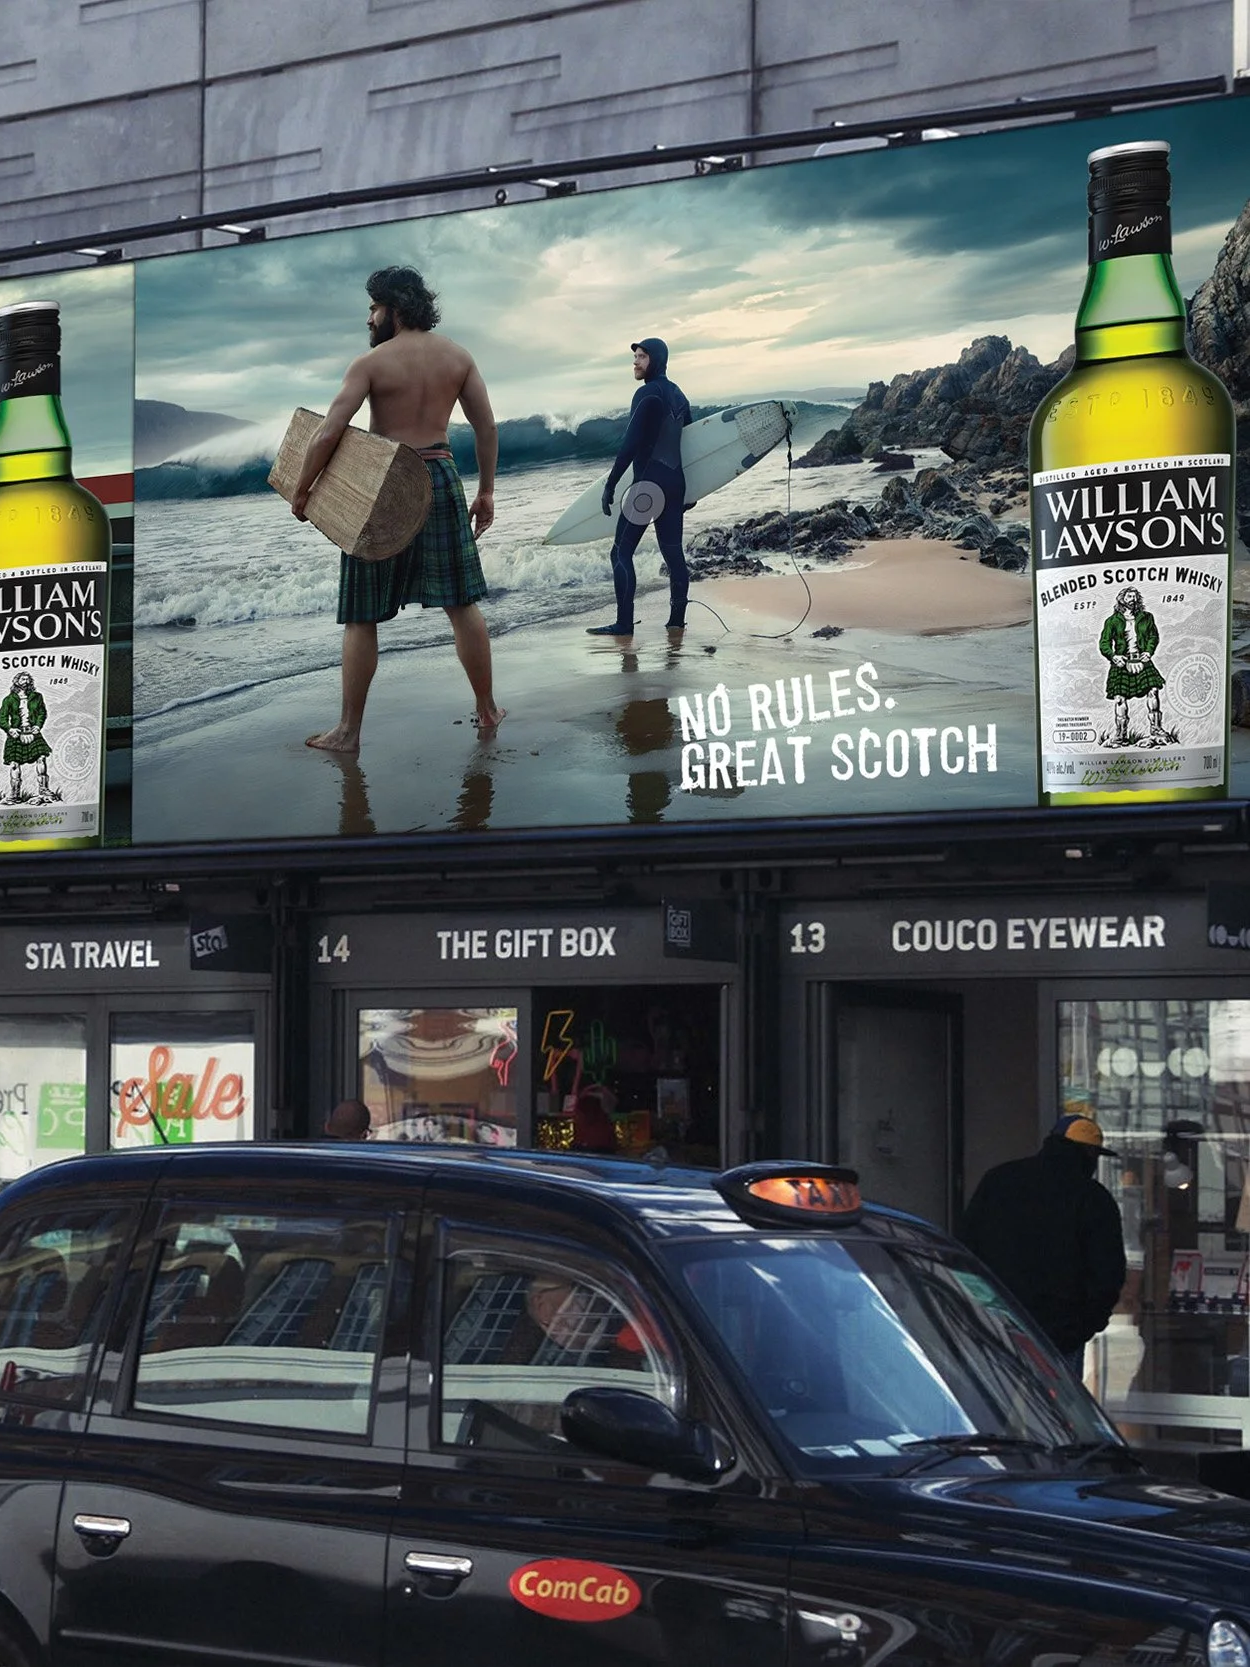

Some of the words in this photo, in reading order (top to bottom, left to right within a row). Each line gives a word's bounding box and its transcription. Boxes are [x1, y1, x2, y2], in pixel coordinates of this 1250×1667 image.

[1084, 468, 1108, 477] AGED
[1124, 462, 1169, 472] BOTTLED
[1045, 476, 1216, 523] WILLIAM
[1040, 512, 1225, 561] LAWSON'S
[20, 567, 57, 576] BOTTLED
[1040, 574, 1097, 607] BLENDED
[1103, 567, 1168, 585] SCOTCH
[1175, 567, 1223, 594] WHISKY
[1162, 594, 1185, 603] 1849
[2, 655, 55, 670] SCOTCH
[61, 655, 100, 677] WHISKY
[678, 683, 732, 742] NO
[748, 661, 898, 732] RULES.
[680, 736, 812, 791] GREAT
[831, 723, 998, 782] SCOTCH
[317, 935, 350, 963] 14
[437, 930, 488, 960] THE
[495, 928, 553, 958] GIFT
[560, 926, 617, 958] BOX
[790, 922, 826, 953] 13
[892, 919, 997, 951] COUCO
[1006, 915, 1166, 950] EYEWEAR
[25, 942, 66, 970] STA
[70, 940, 160, 969] TRAVEL
[116, 1045, 245, 1138] Sale
[518, 1570, 630, 1606] ComCab
